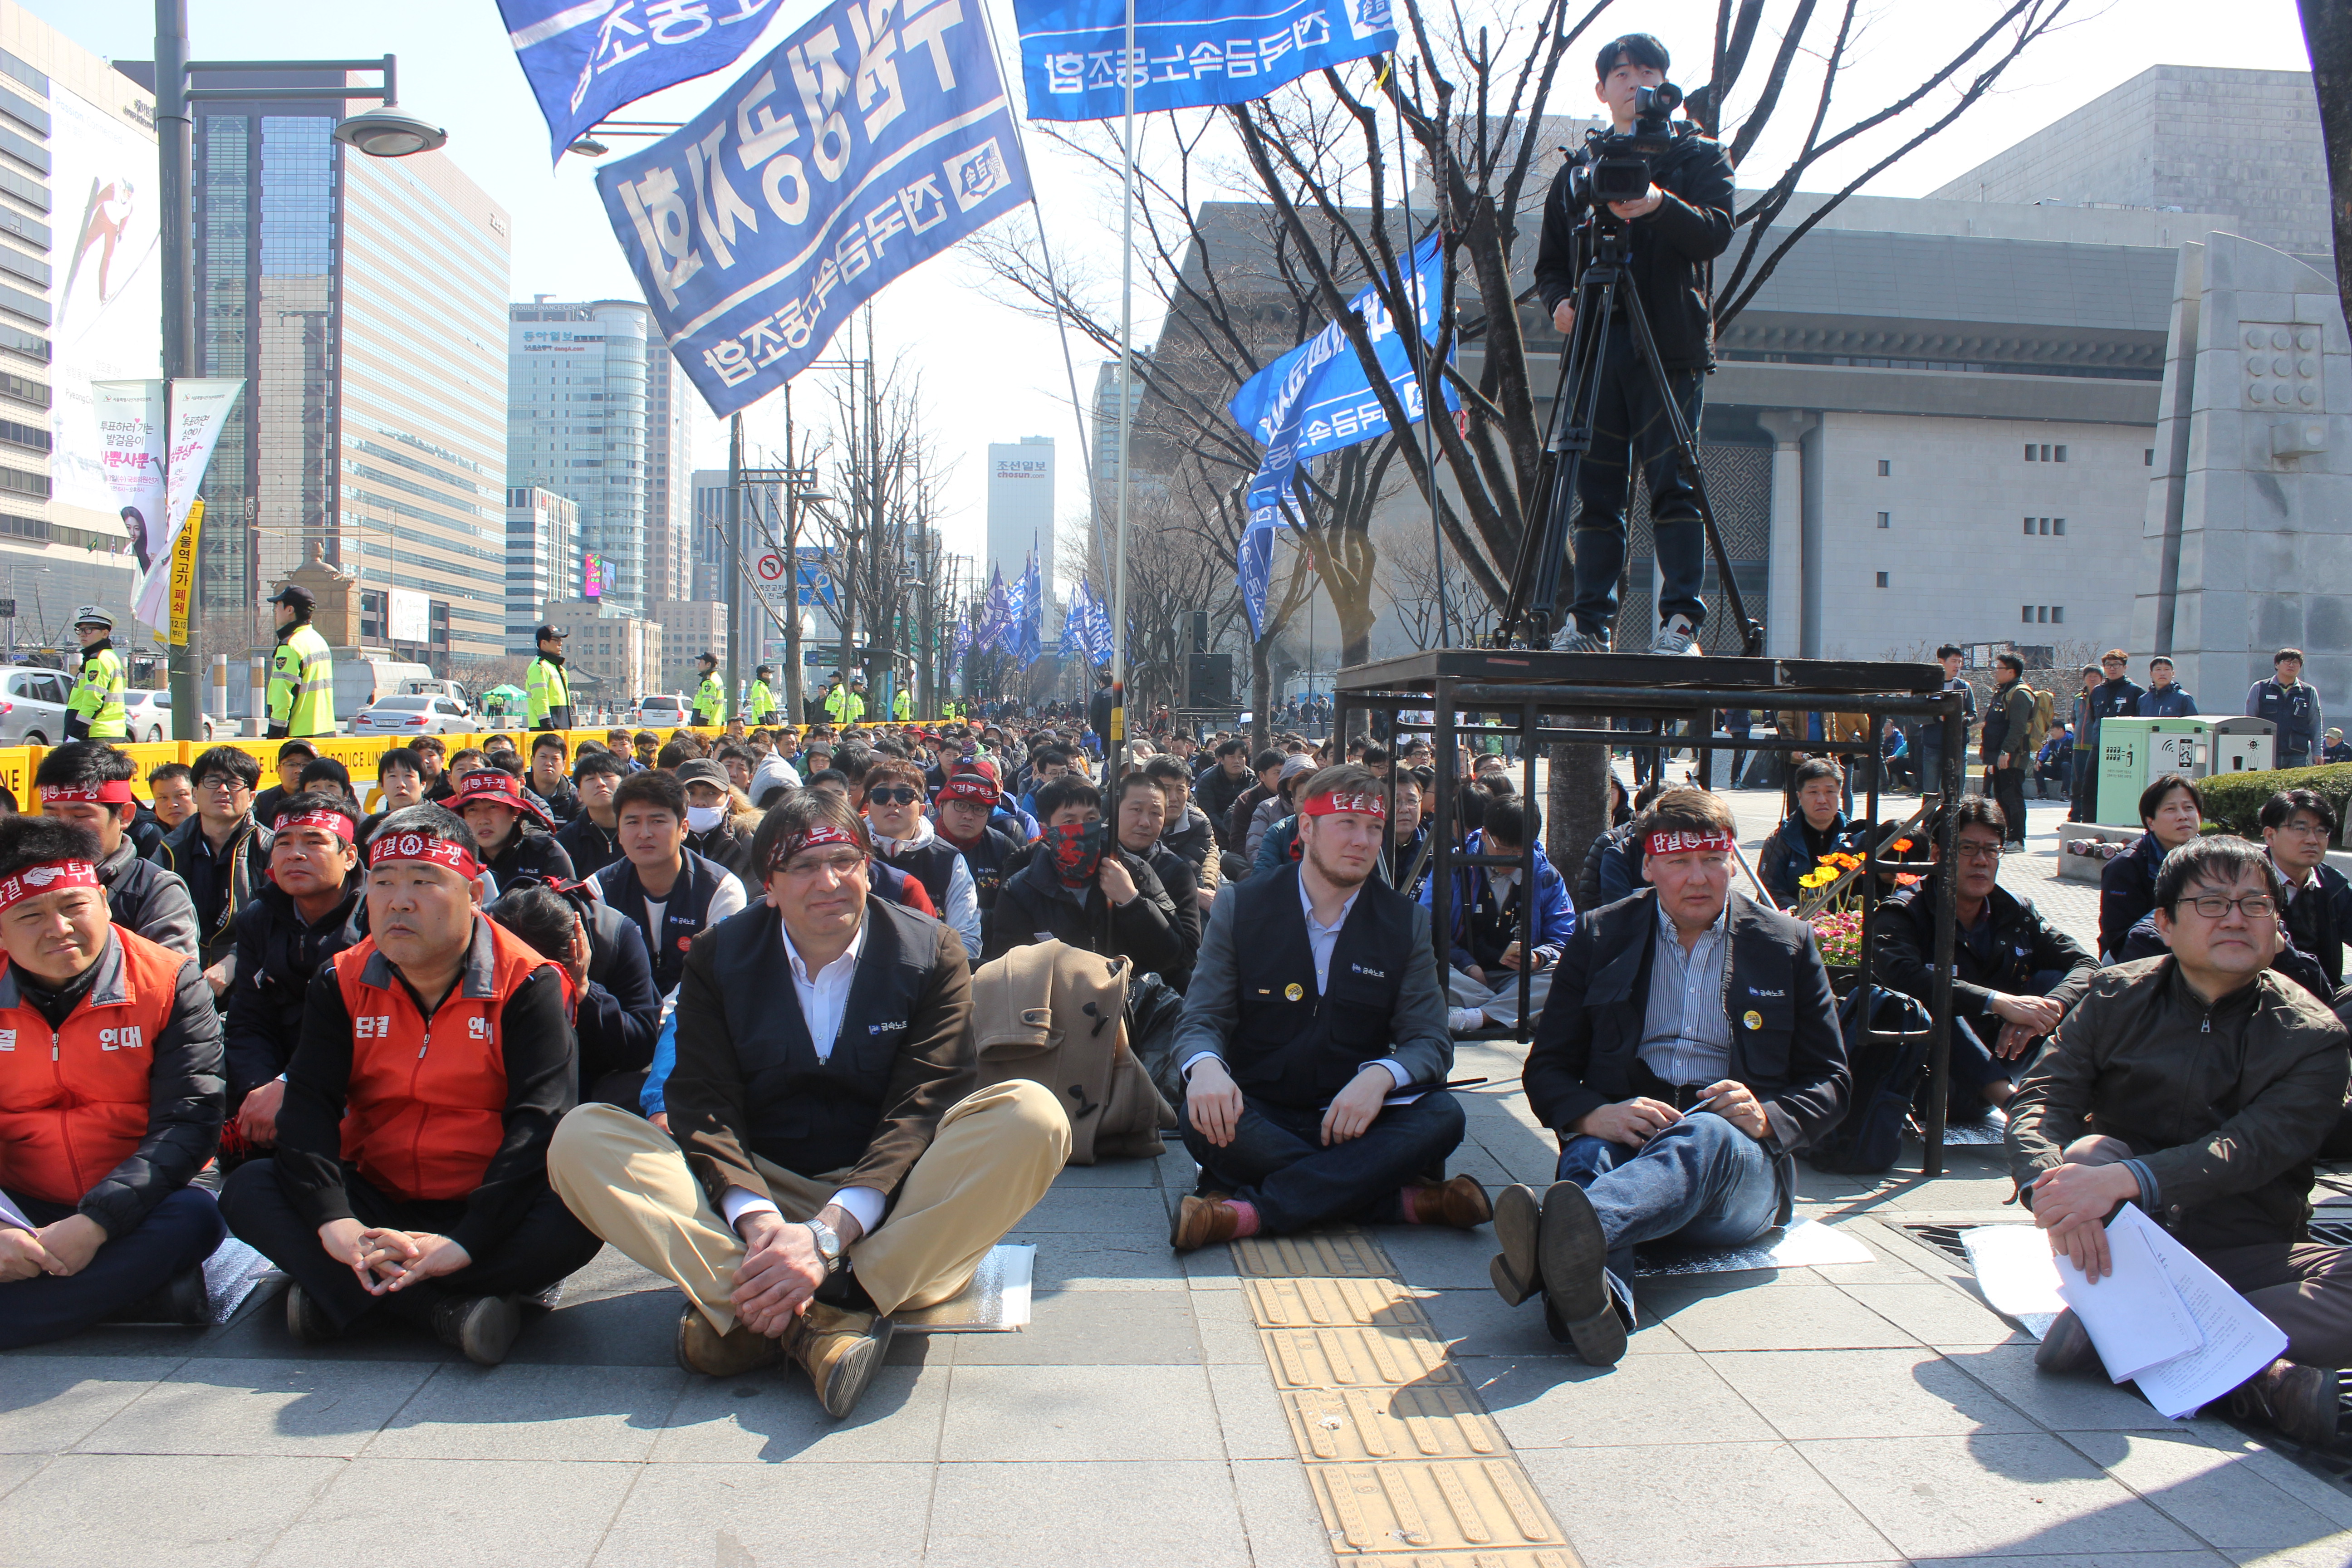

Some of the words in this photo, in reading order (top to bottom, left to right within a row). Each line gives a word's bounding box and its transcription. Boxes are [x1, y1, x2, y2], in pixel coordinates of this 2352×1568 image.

[523, 331, 574, 342] 동아일보
[100, 421, 136, 433] 투표하러
[137, 422, 154, 435] 가는
[106, 435, 144, 447] 발걸음이
[996, 461, 1047, 471] 조선일보
[173, 589, 186, 615] 폐쇄
[171, 620, 186, 629] 12.13
[172, 630, 184, 638] 부터
[331, 751, 364, 768] POLICE
[483, 777, 506, 789] 투쟁
[306, 809, 341, 831] 투쟁
[1653, 833, 1682, 853] 단결
[373, 835, 397, 862] 단결
[424, 838, 462, 866] 투쟁
[68, 861, 97, 884] 투쟁
[678, 917, 696, 925] 금속노조
[1362, 967, 1385, 979] 금속노조
[1760, 989, 1785, 997] 금속노조
[356, 1015, 390, 1039] 단결
[881, 1020, 907, 1032] 금속노조
[98, 1025, 143, 1051] 연대
